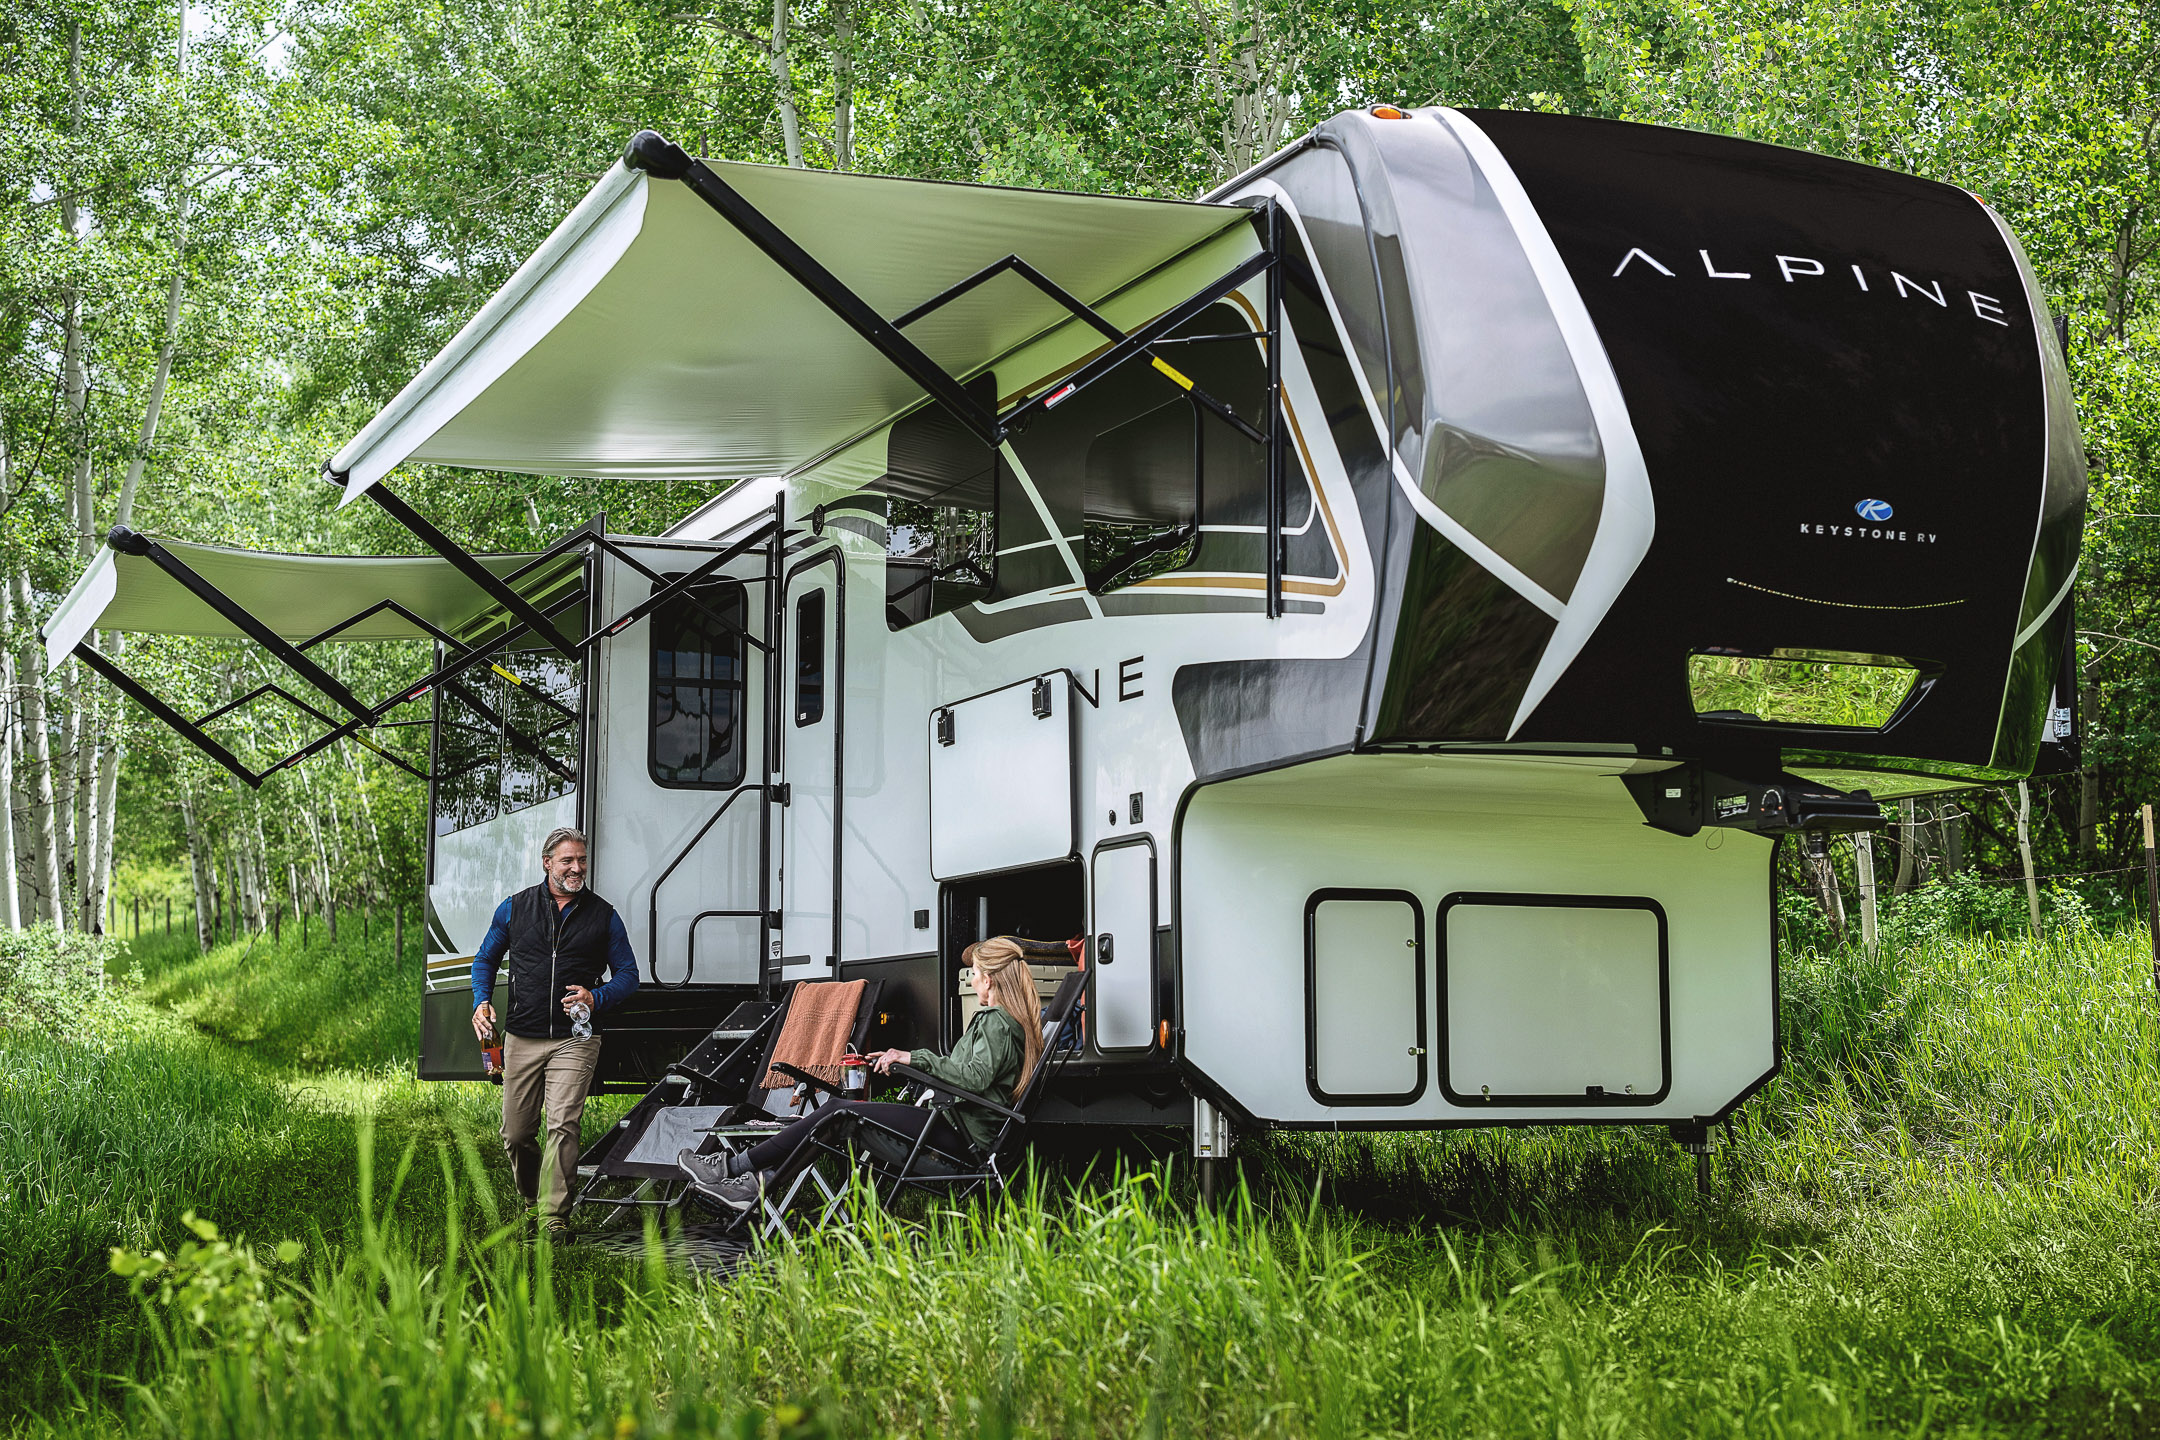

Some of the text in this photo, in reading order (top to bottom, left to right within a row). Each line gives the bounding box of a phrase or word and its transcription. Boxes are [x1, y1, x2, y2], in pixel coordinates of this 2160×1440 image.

[1612, 247, 2009, 327] ALPINE
[1800, 523, 1937, 543] KEYSTONE RV
